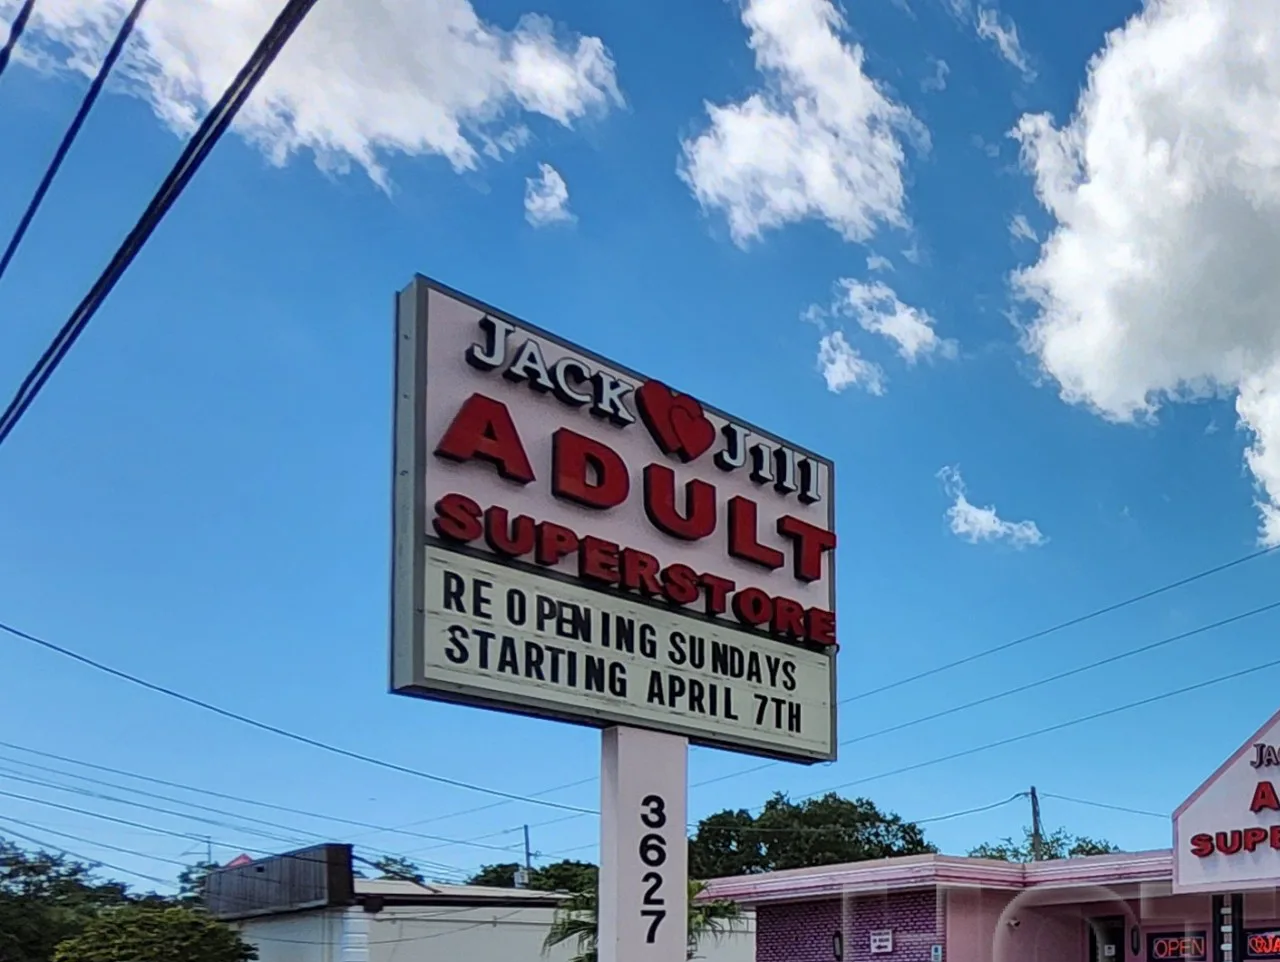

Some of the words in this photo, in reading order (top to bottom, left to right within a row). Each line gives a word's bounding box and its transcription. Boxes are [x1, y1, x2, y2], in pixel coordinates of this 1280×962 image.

[466, 314, 635, 426] JACK
[434, 392, 837, 582] ADULT
[434, 493, 838, 645] SUPERSTORE
[443, 570, 493, 620] RE
[506, 587, 657, 659] OPENING
[669, 631, 797, 692] SUNDAYS
[445, 624, 627, 699] STARTING
[647, 670, 738, 721] APRIL
[752, 694, 801, 734] 7TH
[639, 794, 667, 943] 3627
[1154, 938, 1205, 958] OPEN
